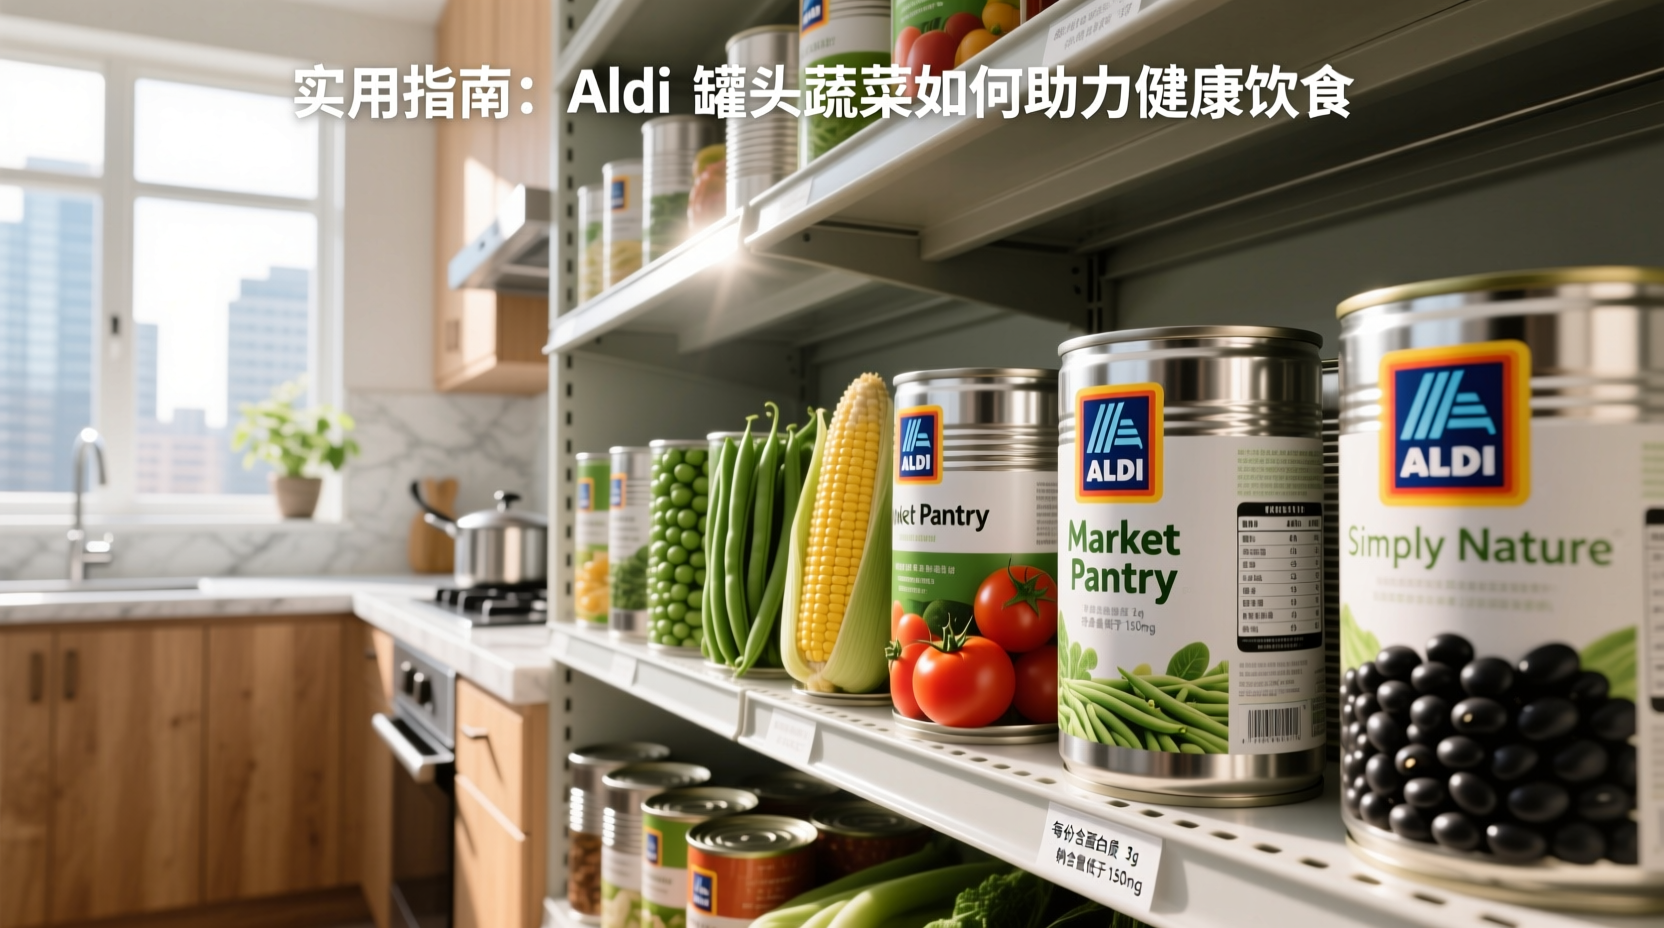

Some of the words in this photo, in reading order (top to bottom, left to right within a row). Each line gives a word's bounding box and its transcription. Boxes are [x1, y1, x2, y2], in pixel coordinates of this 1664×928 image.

[901, 454, 931, 471] ALDI
[1086, 458, 1144, 482] ALDI
[1400, 445, 1496, 478] ALDI
[920, 503, 990, 532] Pantry
[1068, 519, 1181, 556] Market
[1348, 525, 1445, 570] Simply
[1459, 527, 1614, 567] Nature
[1071, 557, 1178, 605] Pantry
[1125, 846, 1140, 867] 3g
